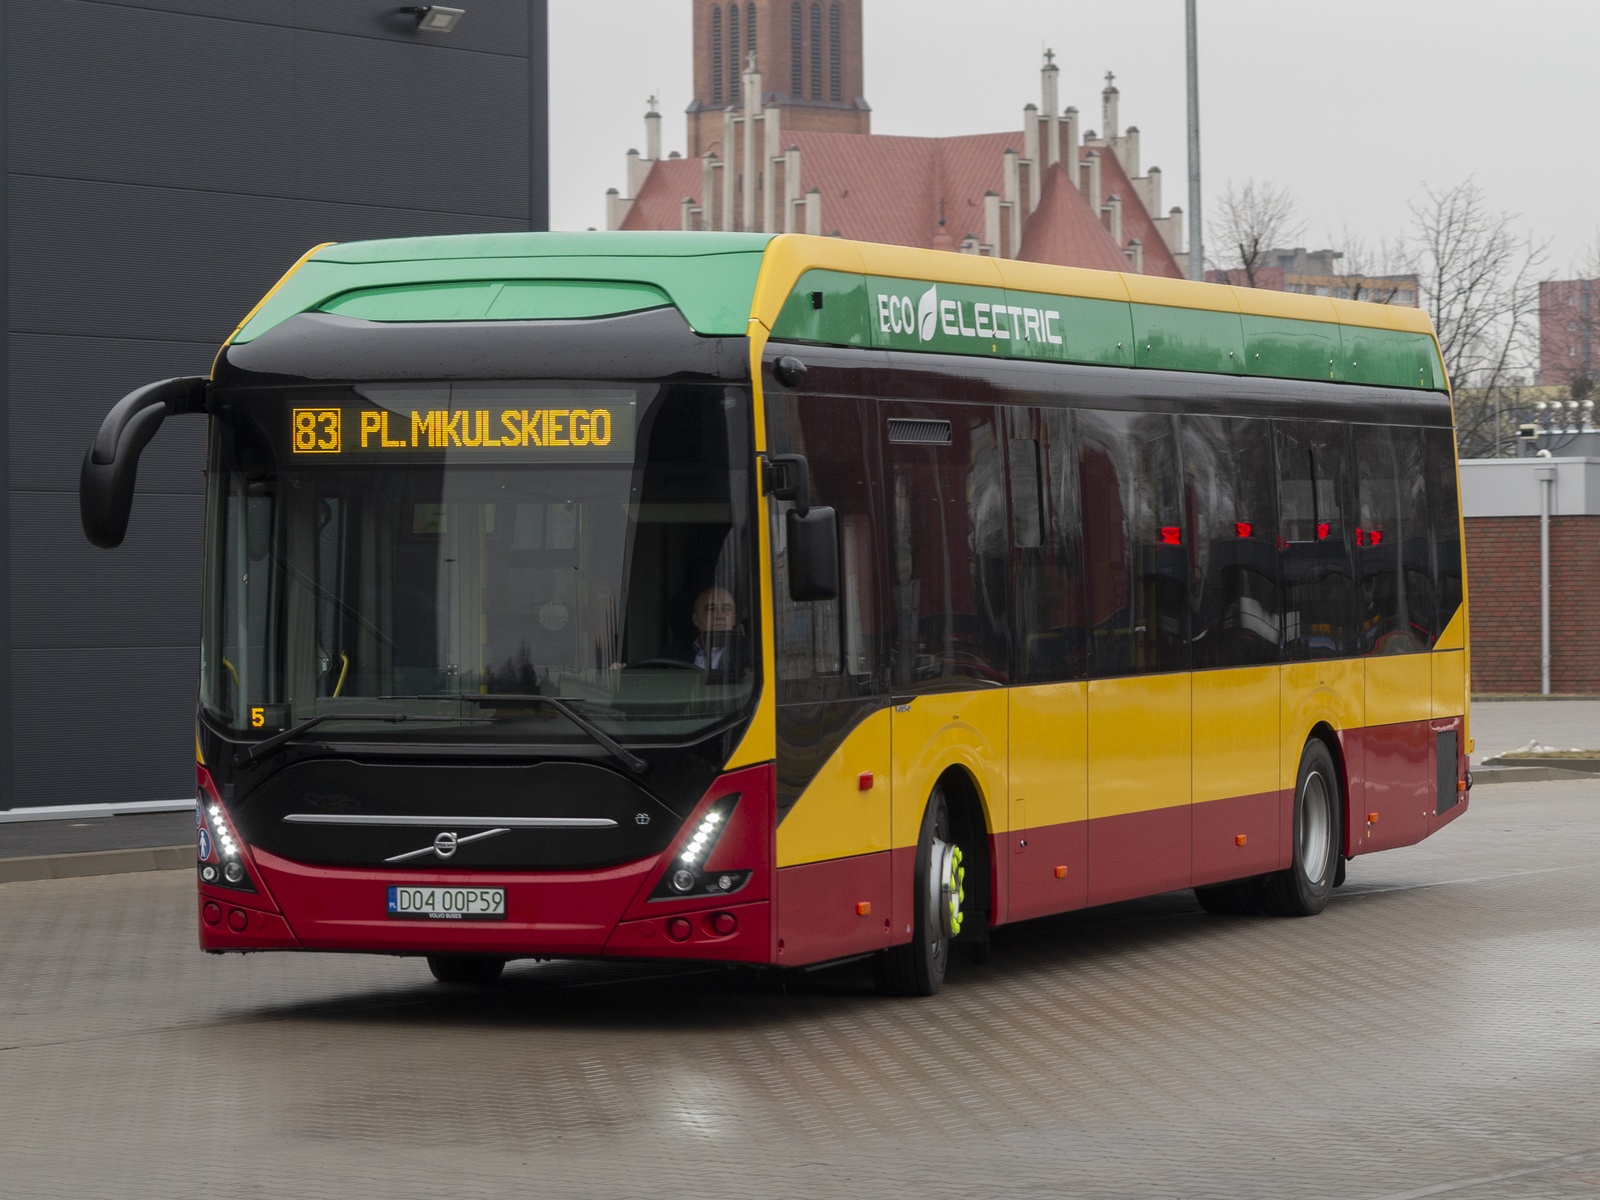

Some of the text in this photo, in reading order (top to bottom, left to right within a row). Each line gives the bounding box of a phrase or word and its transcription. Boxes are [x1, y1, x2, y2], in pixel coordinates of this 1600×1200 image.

[878, 294, 1063, 345] ECO ELECTRIC
[296, 411, 338, 450] 83
[251, 707, 265, 727] 5
